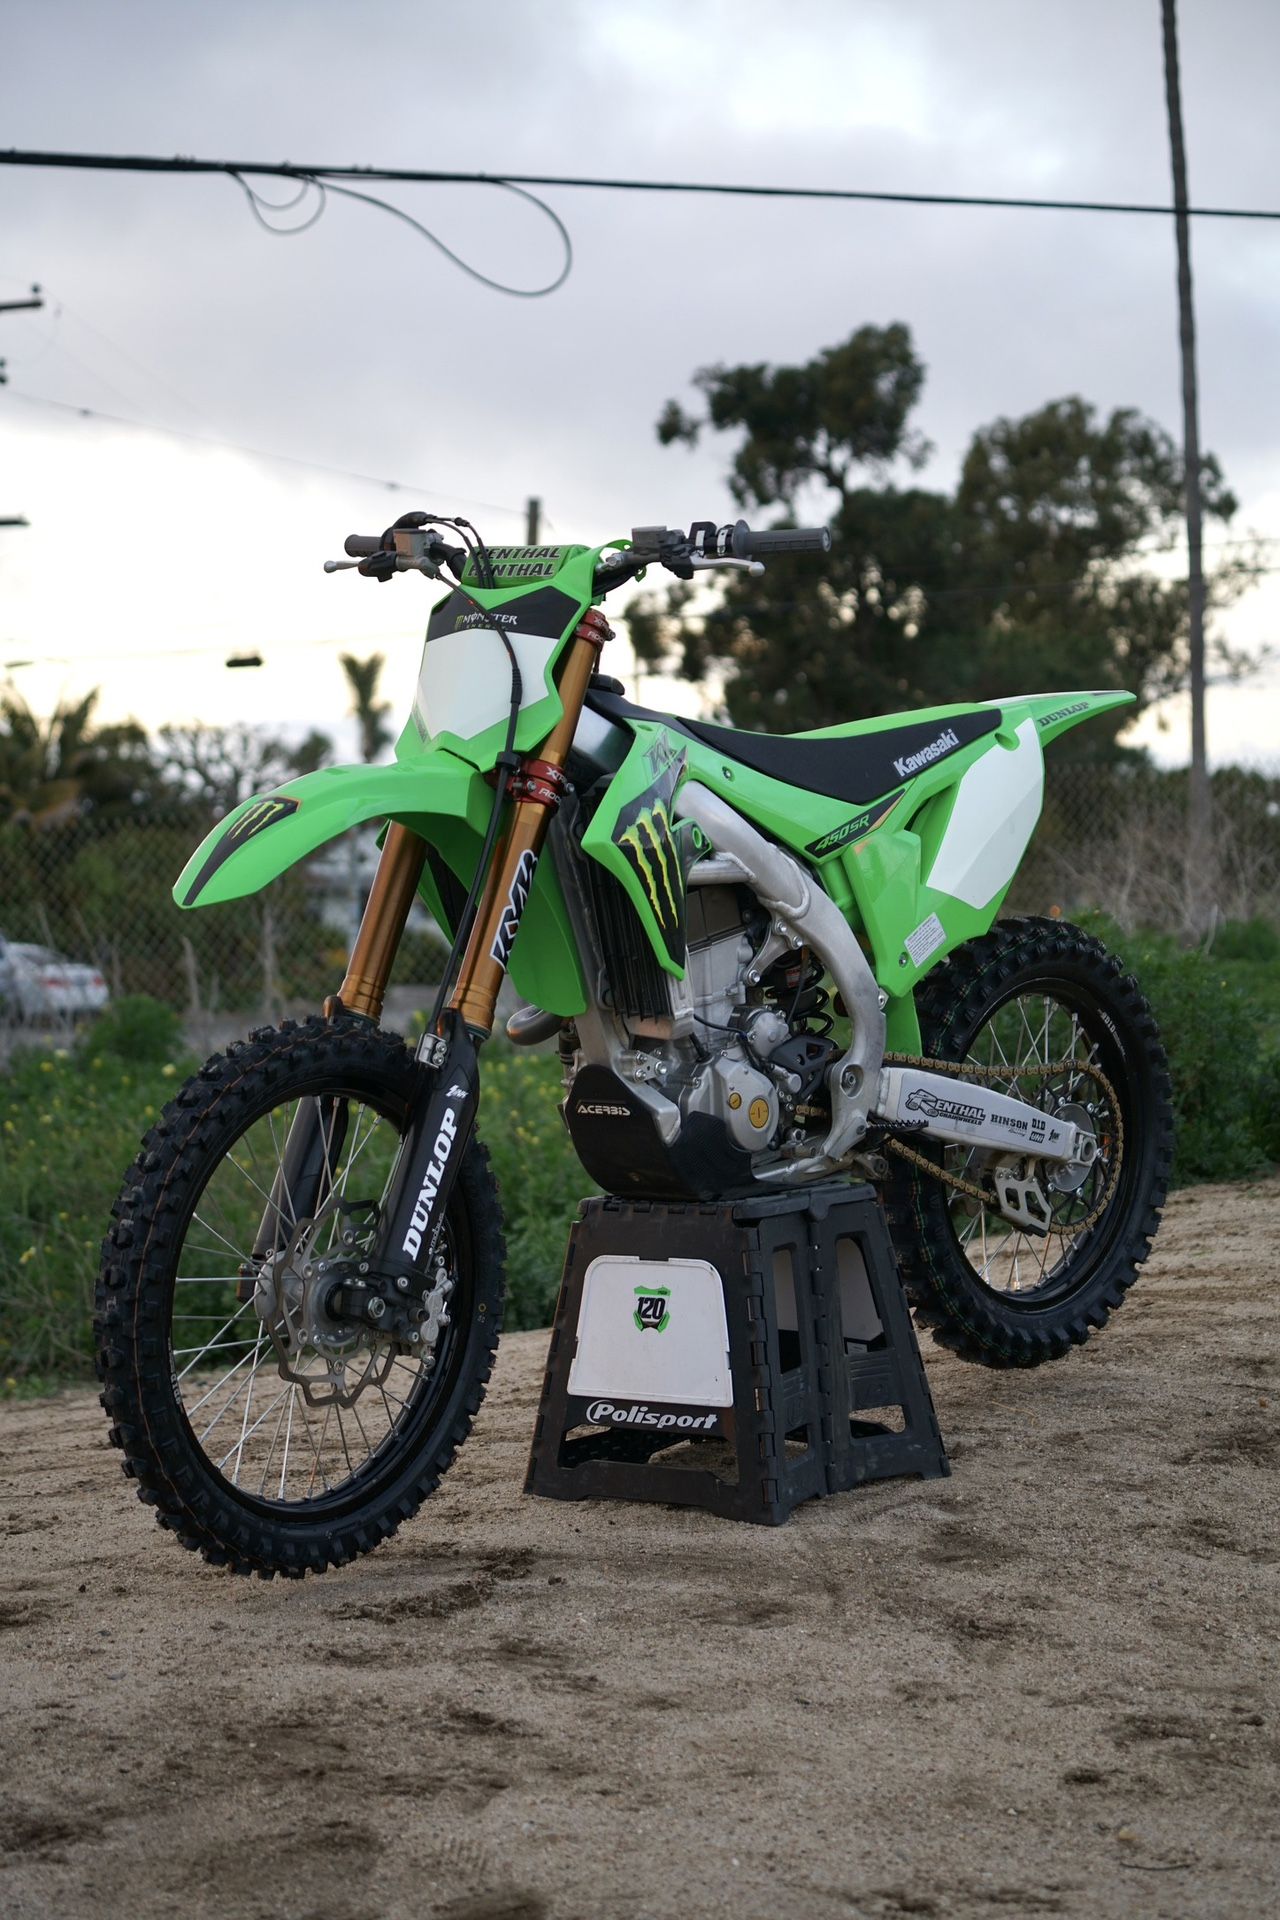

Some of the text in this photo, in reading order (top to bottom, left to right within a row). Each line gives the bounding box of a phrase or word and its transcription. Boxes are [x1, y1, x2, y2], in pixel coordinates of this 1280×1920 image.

[1037, 701, 1089, 726] DUNLOP
[893, 728, 960, 777] Kawasaki
[814, 813, 871, 852] 450SR
[577, 1104, 631, 1116] ACERBIS
[990, 1113, 1029, 1131] HINSON
[402, 1107, 459, 1262] DUNLOP
[637, 1296, 666, 1320] 120
[588, 1400, 717, 1429] Polisport
